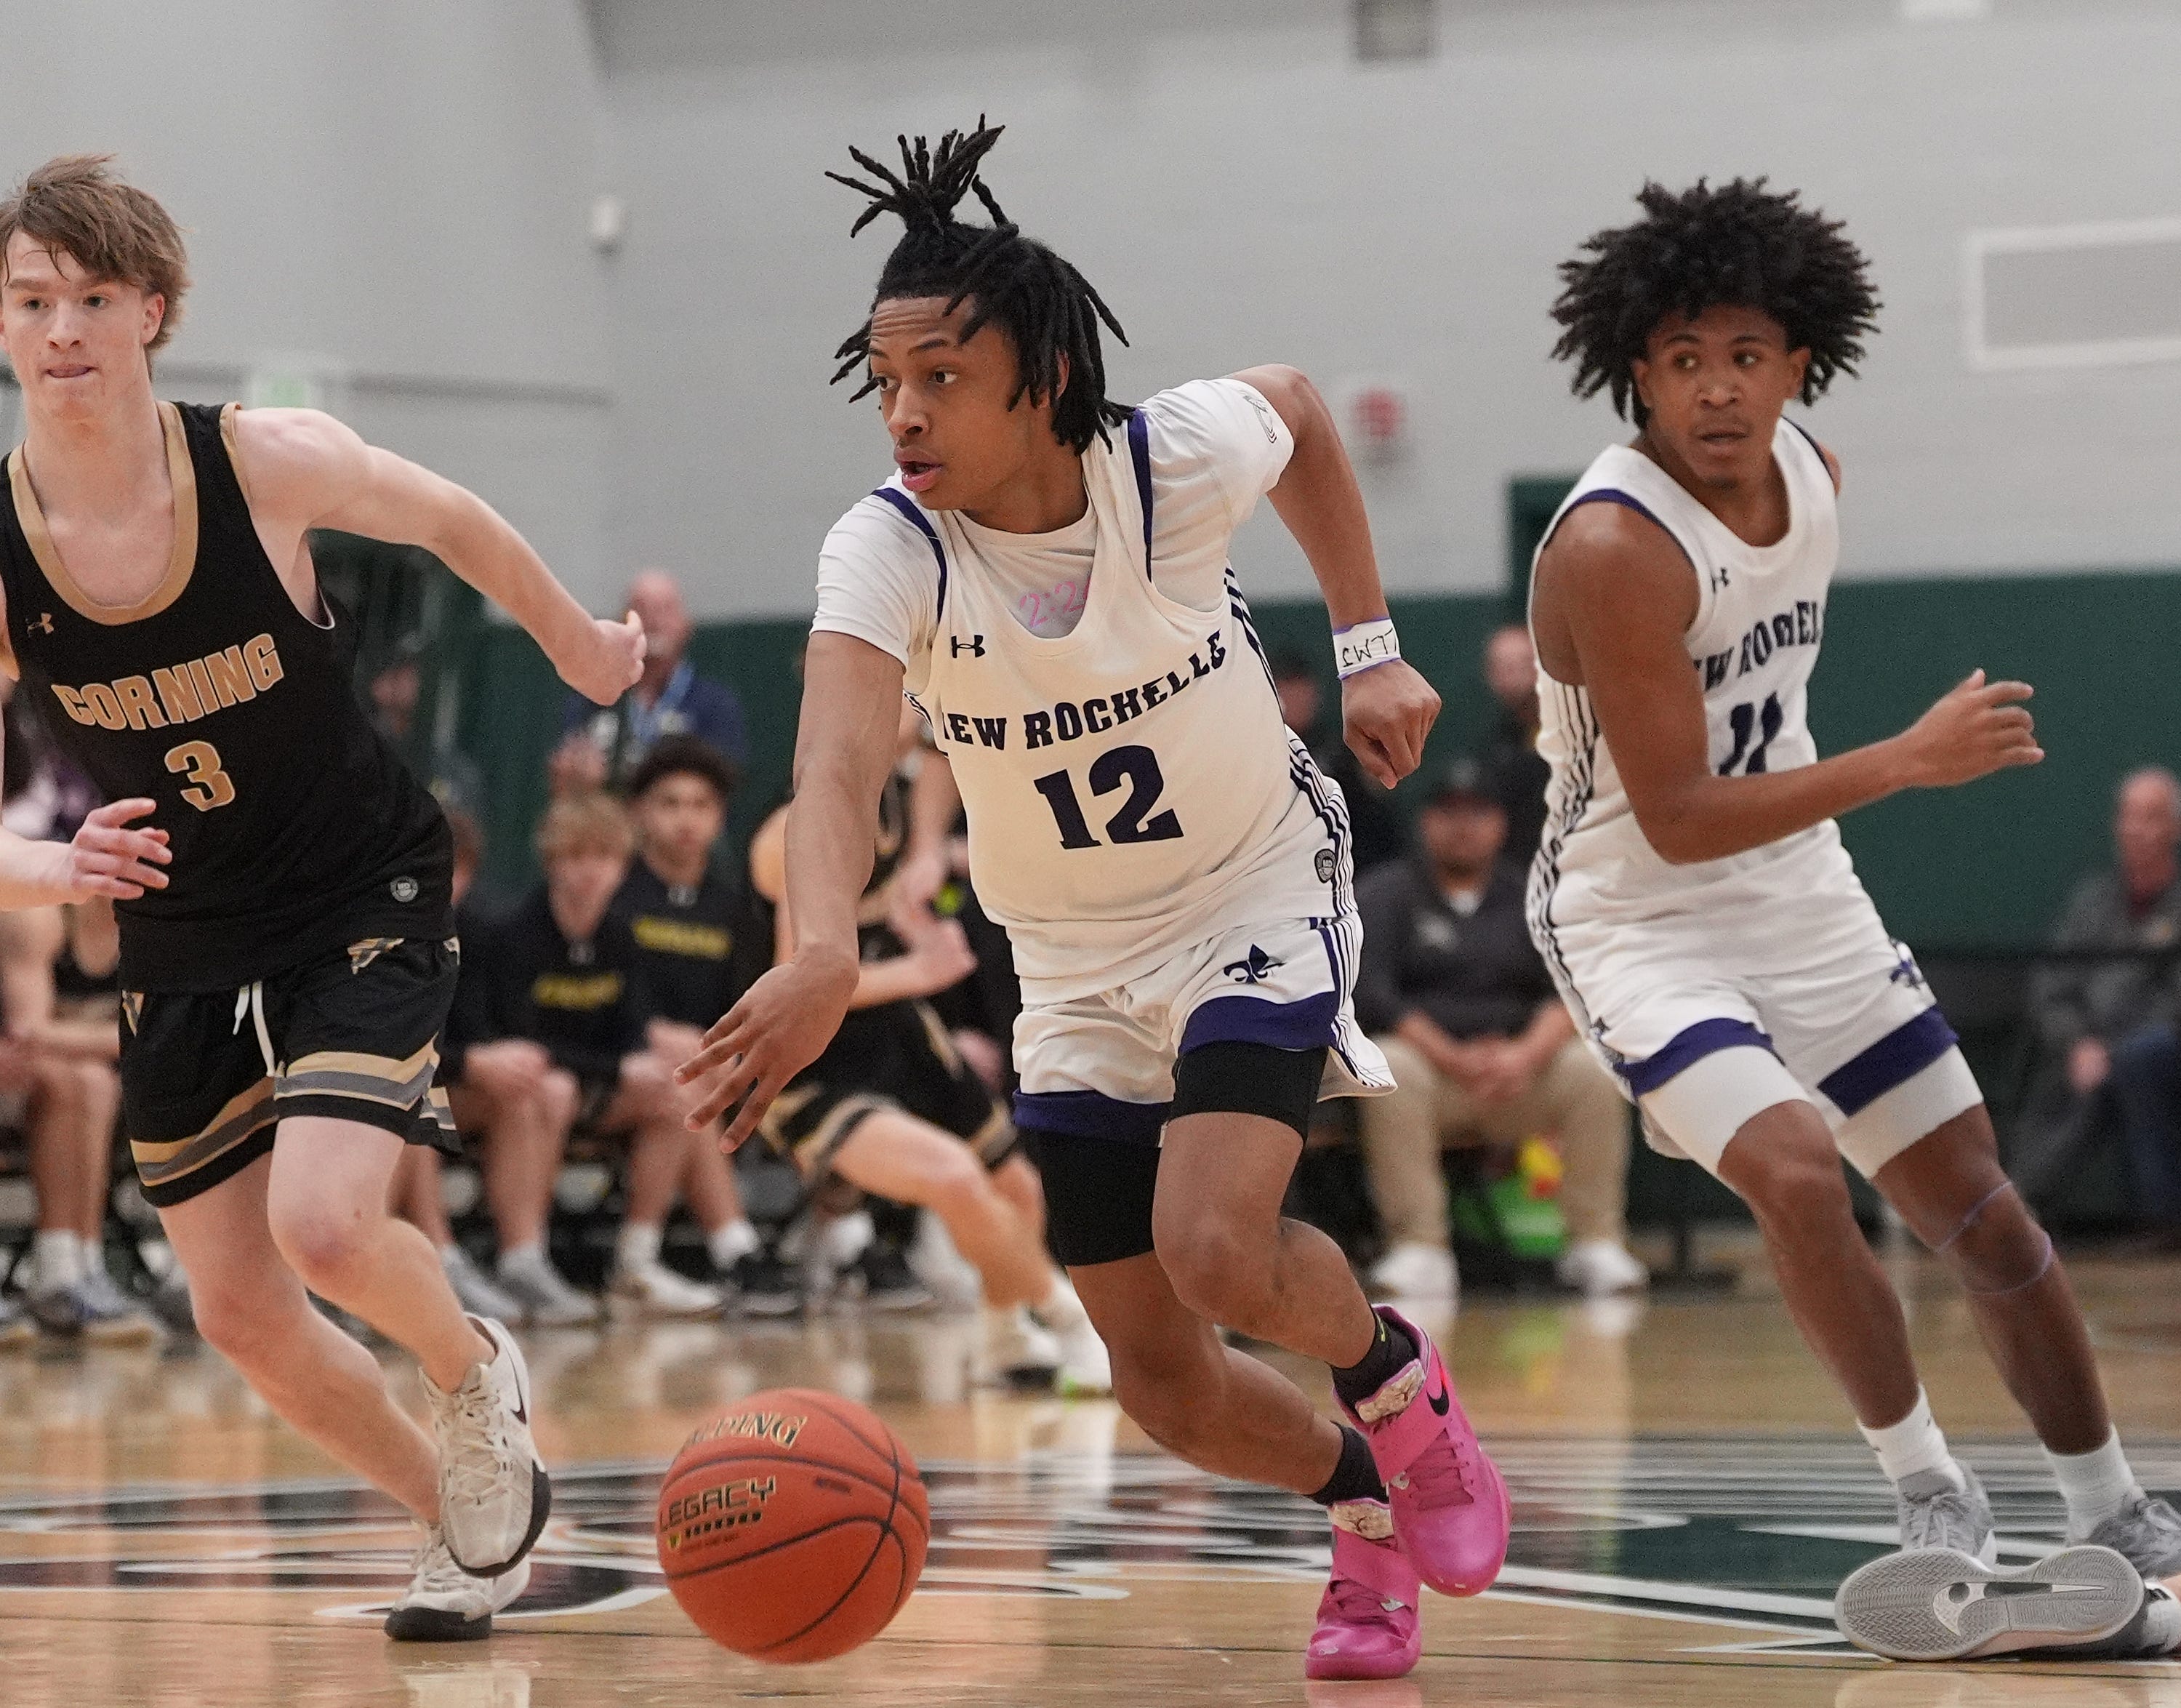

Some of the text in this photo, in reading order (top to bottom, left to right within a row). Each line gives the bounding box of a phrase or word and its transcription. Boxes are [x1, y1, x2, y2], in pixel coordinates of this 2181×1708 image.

[51, 633, 284, 730] CORNING
[1023, 628, 1226, 750] ROCHELLE
[164, 739, 236, 811] 3
[1034, 745, 1184, 850] 12
[659, 1475, 776, 1533] LEGACY
